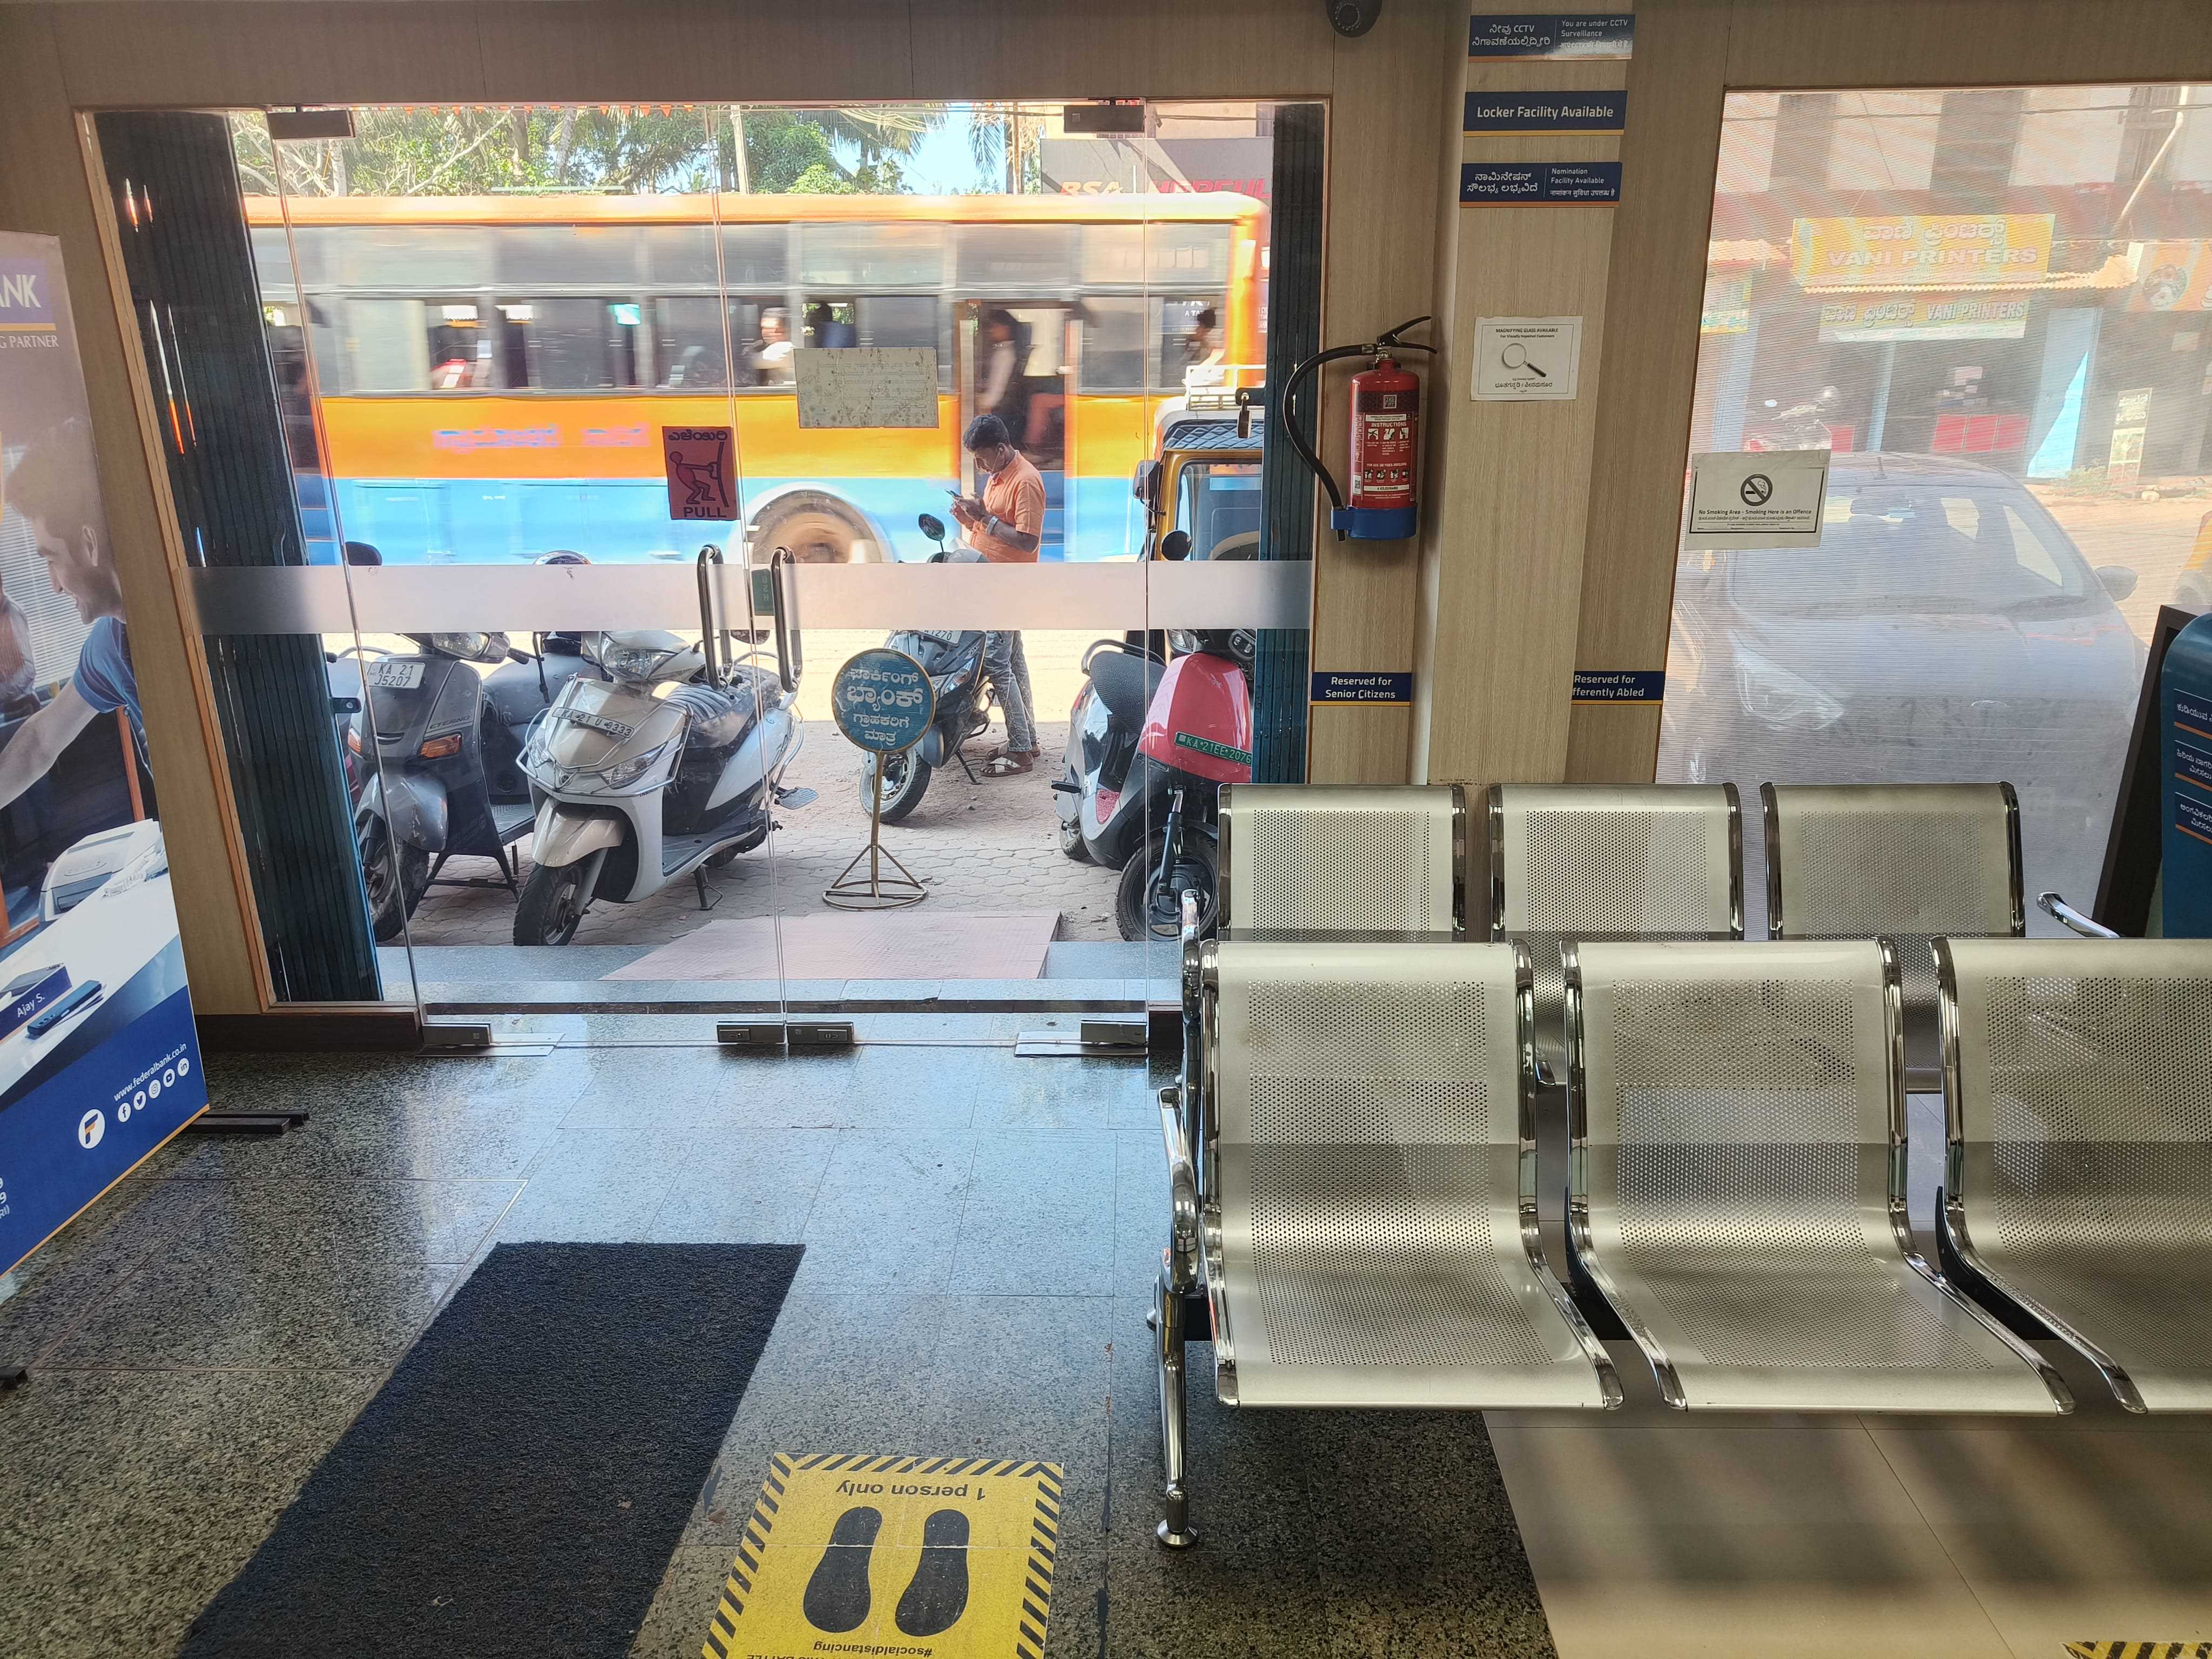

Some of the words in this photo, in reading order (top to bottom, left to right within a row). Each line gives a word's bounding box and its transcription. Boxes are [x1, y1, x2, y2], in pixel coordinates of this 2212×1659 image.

[1478, 106, 1514, 118] Locker
[1518, 106, 1558, 120] Facility
[1561, 106, 1613, 117] Available
[1828, 250, 1891, 266] VANI
[1902, 247, 2038, 265] PRINTERS
[1927, 303, 1956, 321] VANI
[1960, 302, 2026, 321] PRINTERS
[10, 335, 59, 348] PARTNER
[684, 507, 727, 518] PULL
[378, 664, 393, 675] KA
[400, 664, 414, 676] 21
[374, 674, 411, 686] J5207
[1331, 677, 1375, 685] Reserved
[1378, 677, 1392, 685] for
[1574, 675, 1619, 683] Reserved
[1622, 675, 1636, 683] for
[1325, 690, 1355, 698] Senior
[1358, 690, 1395, 699] Citizens
[1573, 687, 1615, 698] fferently
[1617, 688, 1644, 697] Abled
[561, 709, 575, 719] KA
[1186, 738, 1201, 748] KA
[17, 1000, 35, 1017] Ajay
[36, 993, 45, 1003] S.
[113, 1043, 187, 1102] www.federalbank.co.in
[835, 1480, 885, 1495] only
[891, 1483, 968, 1499] person
[976, 1487, 986, 1501] 1
[813, 1641, 933, 1657] #socialdistancing
